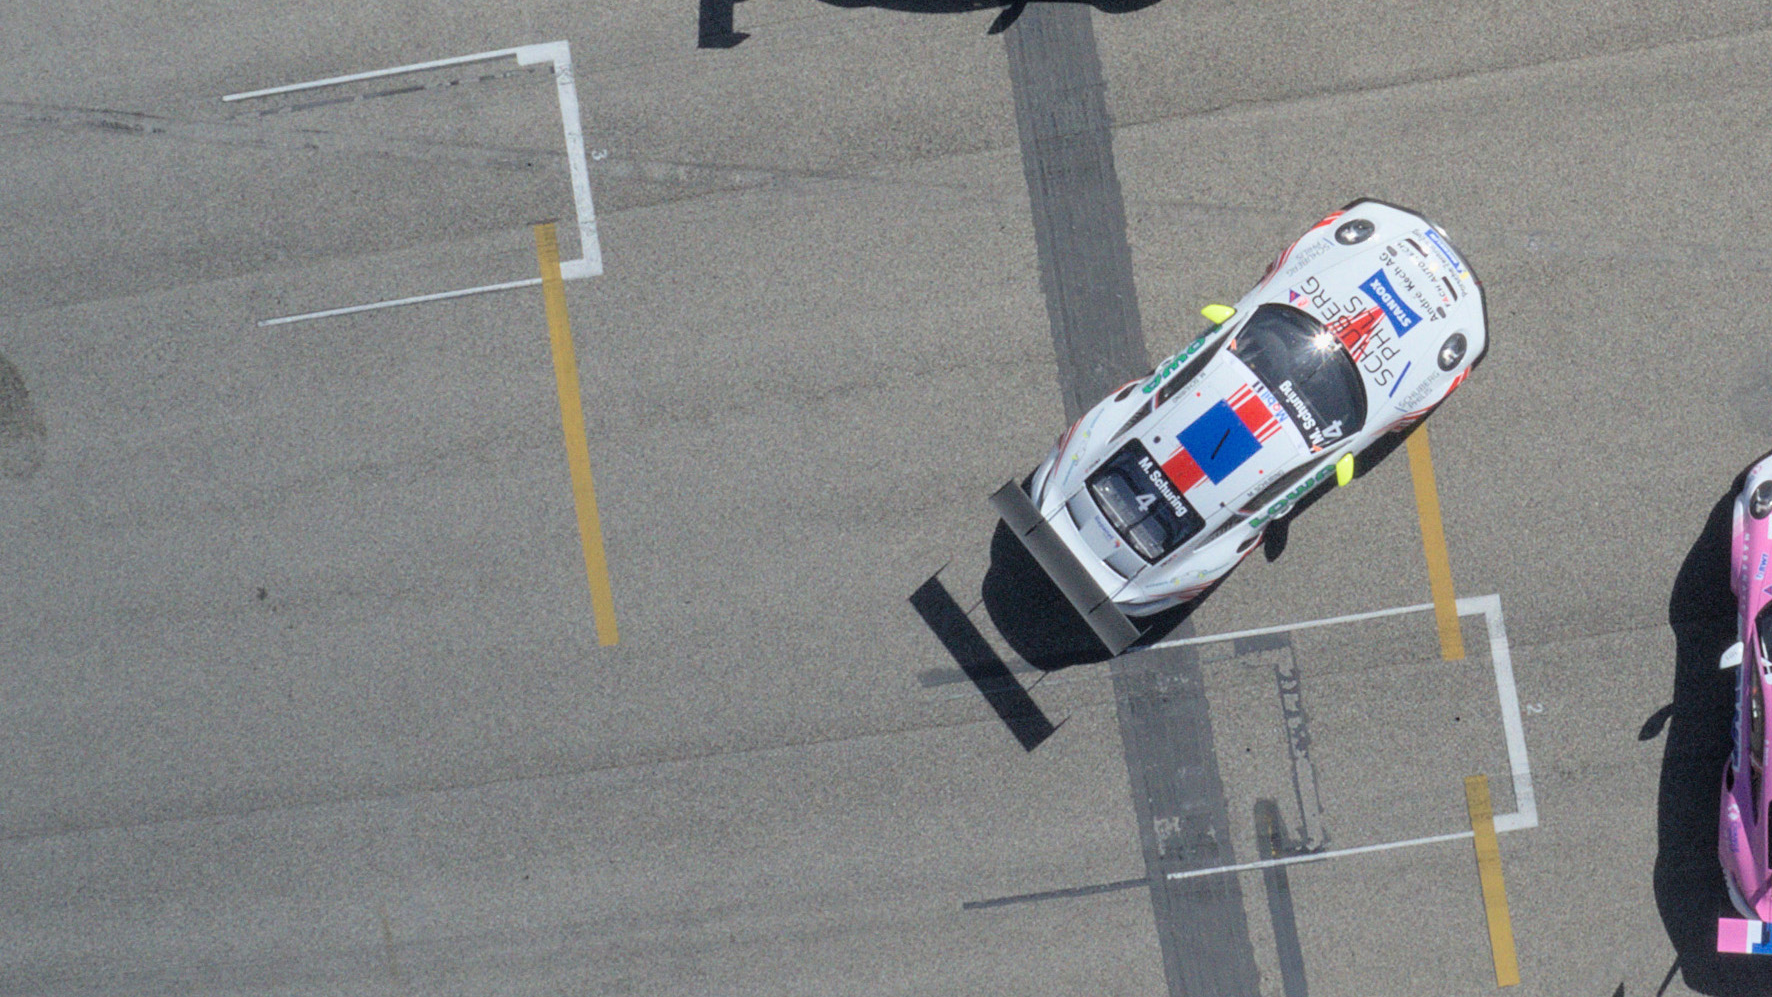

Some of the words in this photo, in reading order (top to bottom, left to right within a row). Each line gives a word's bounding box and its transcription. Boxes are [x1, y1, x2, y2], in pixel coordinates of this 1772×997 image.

[592, 149, 607, 161] 3
[1378, 252, 1394, 266] AG
[1417, 261, 1438, 283] AUTO
[1394, 266, 1415, 291] Koch
[1370, 279, 1411, 326] STANDOX
[1414, 292, 1438, 322] André
[1434, 284, 1451, 307] FACH
[1299, 275, 1394, 387] SCHUBERG
[1342, 294, 1401, 361] PHILIS
[1139, 323, 1223, 396] LOWA
[1260, 390, 1290, 422] Mobil
[1278, 379, 1315, 430] Schuring
[1309, 427, 1324, 445] M.
[1321, 419, 1342, 442] 4
[1137, 456, 1153, 474] M.
[1148, 469, 1187, 517] Schuring
[1248, 460, 1336, 529] LOWA
[1134, 492, 1156, 512] 4
[1526, 703, 1543, 715] 2
